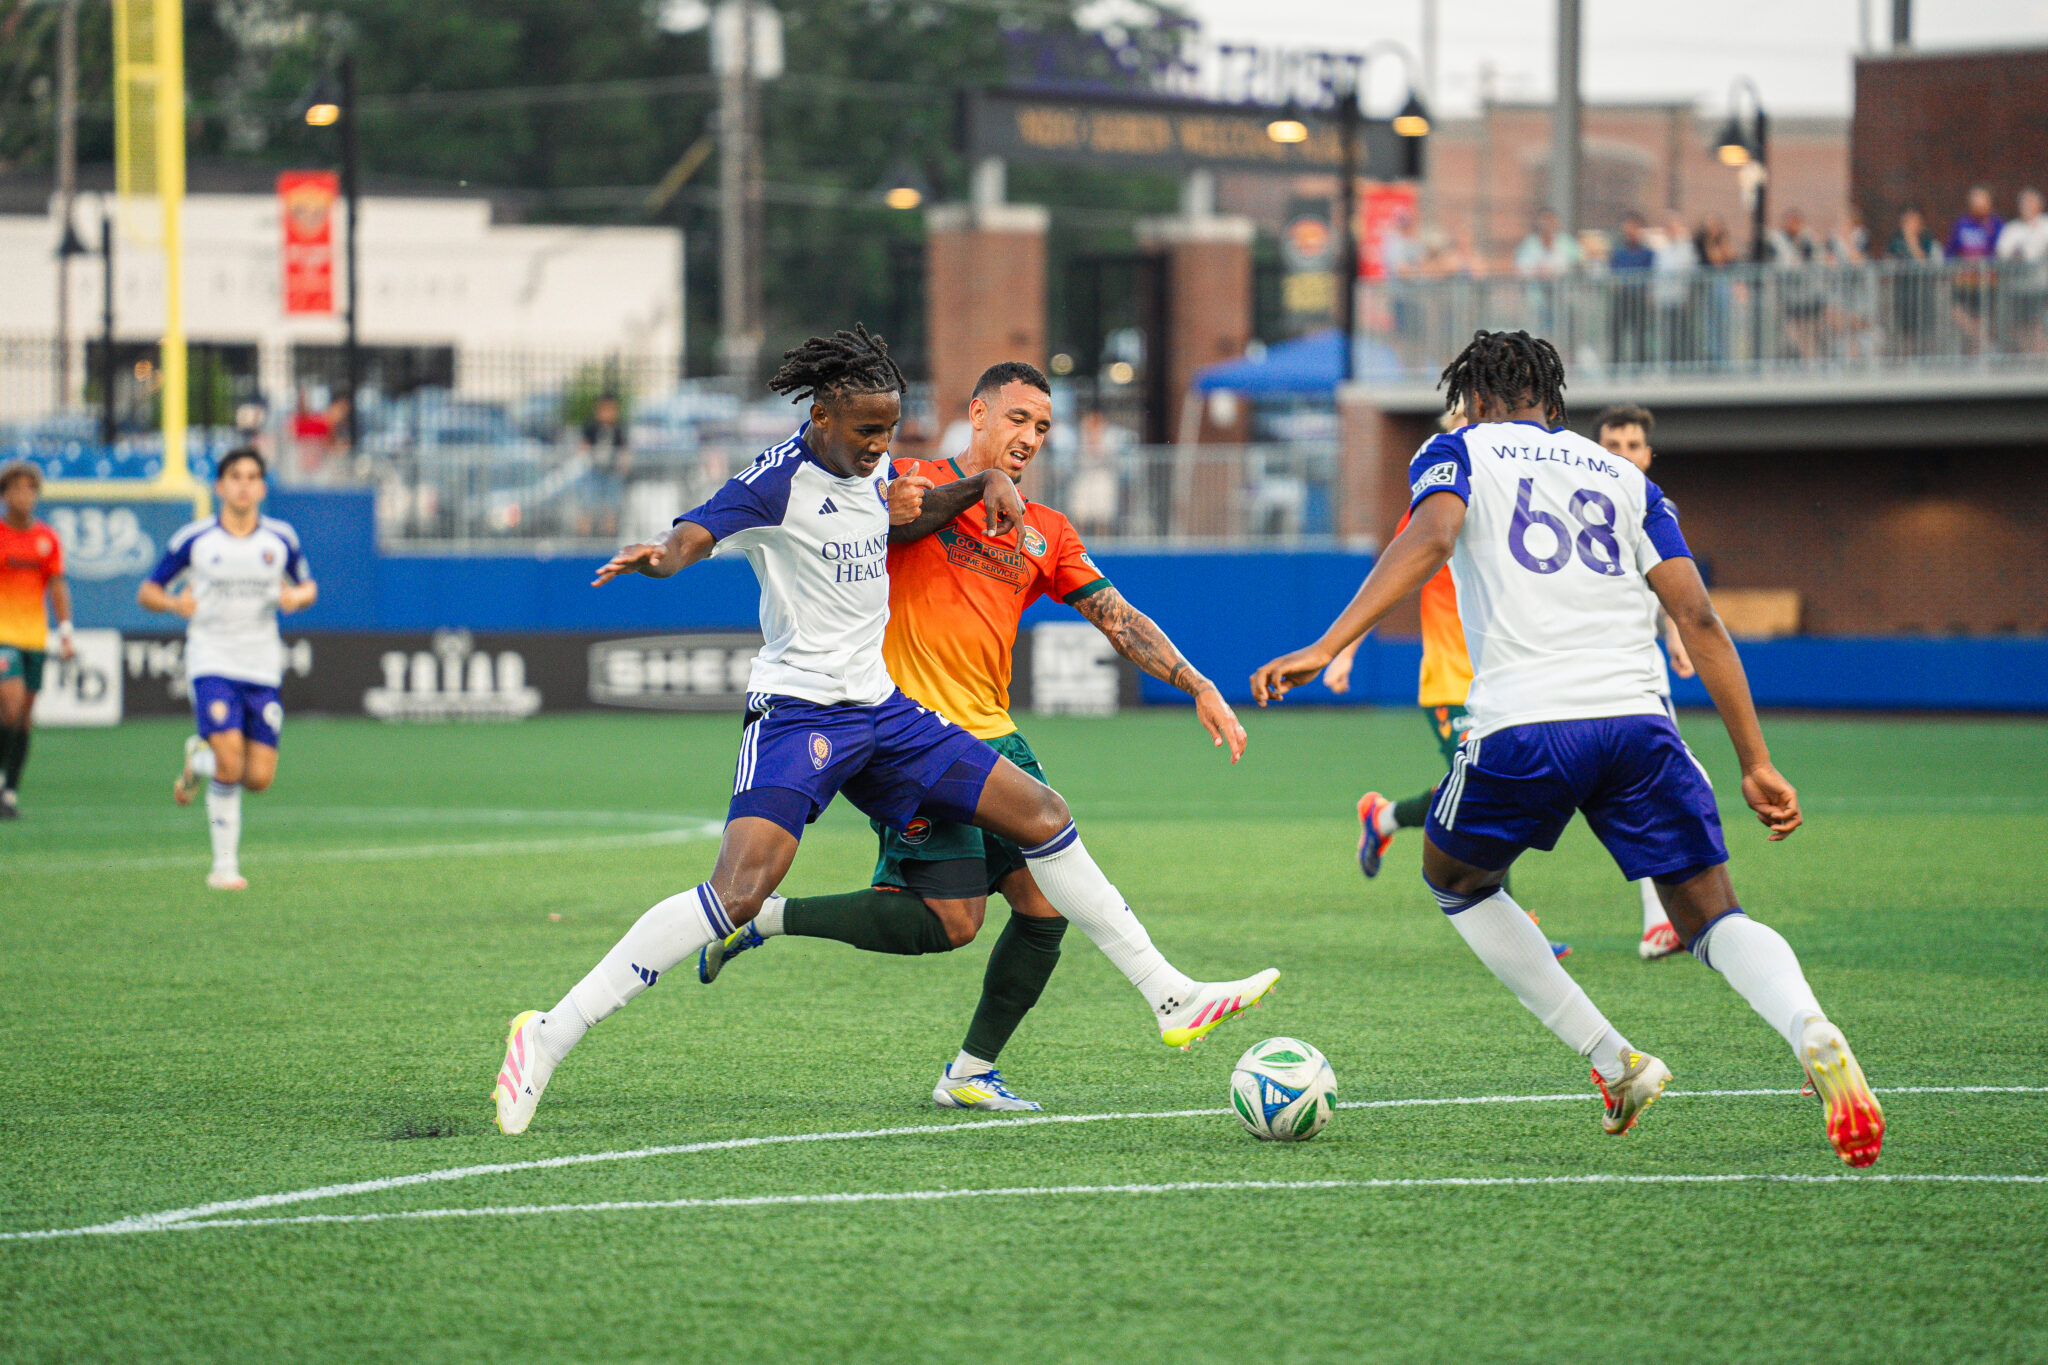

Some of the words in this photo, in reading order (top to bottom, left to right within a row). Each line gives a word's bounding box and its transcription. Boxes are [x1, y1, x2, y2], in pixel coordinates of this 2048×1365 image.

[1491, 445, 1619, 478] WILLIAMS
[1508, 477, 1625, 576] 68
[822, 532, 888, 560] ORLAN
[955, 536, 1022, 569] GO-FORTH
[835, 556, 886, 583] HEALT
[953, 550, 980, 568] HOME
[981, 559, 1019, 580] SERVICES
